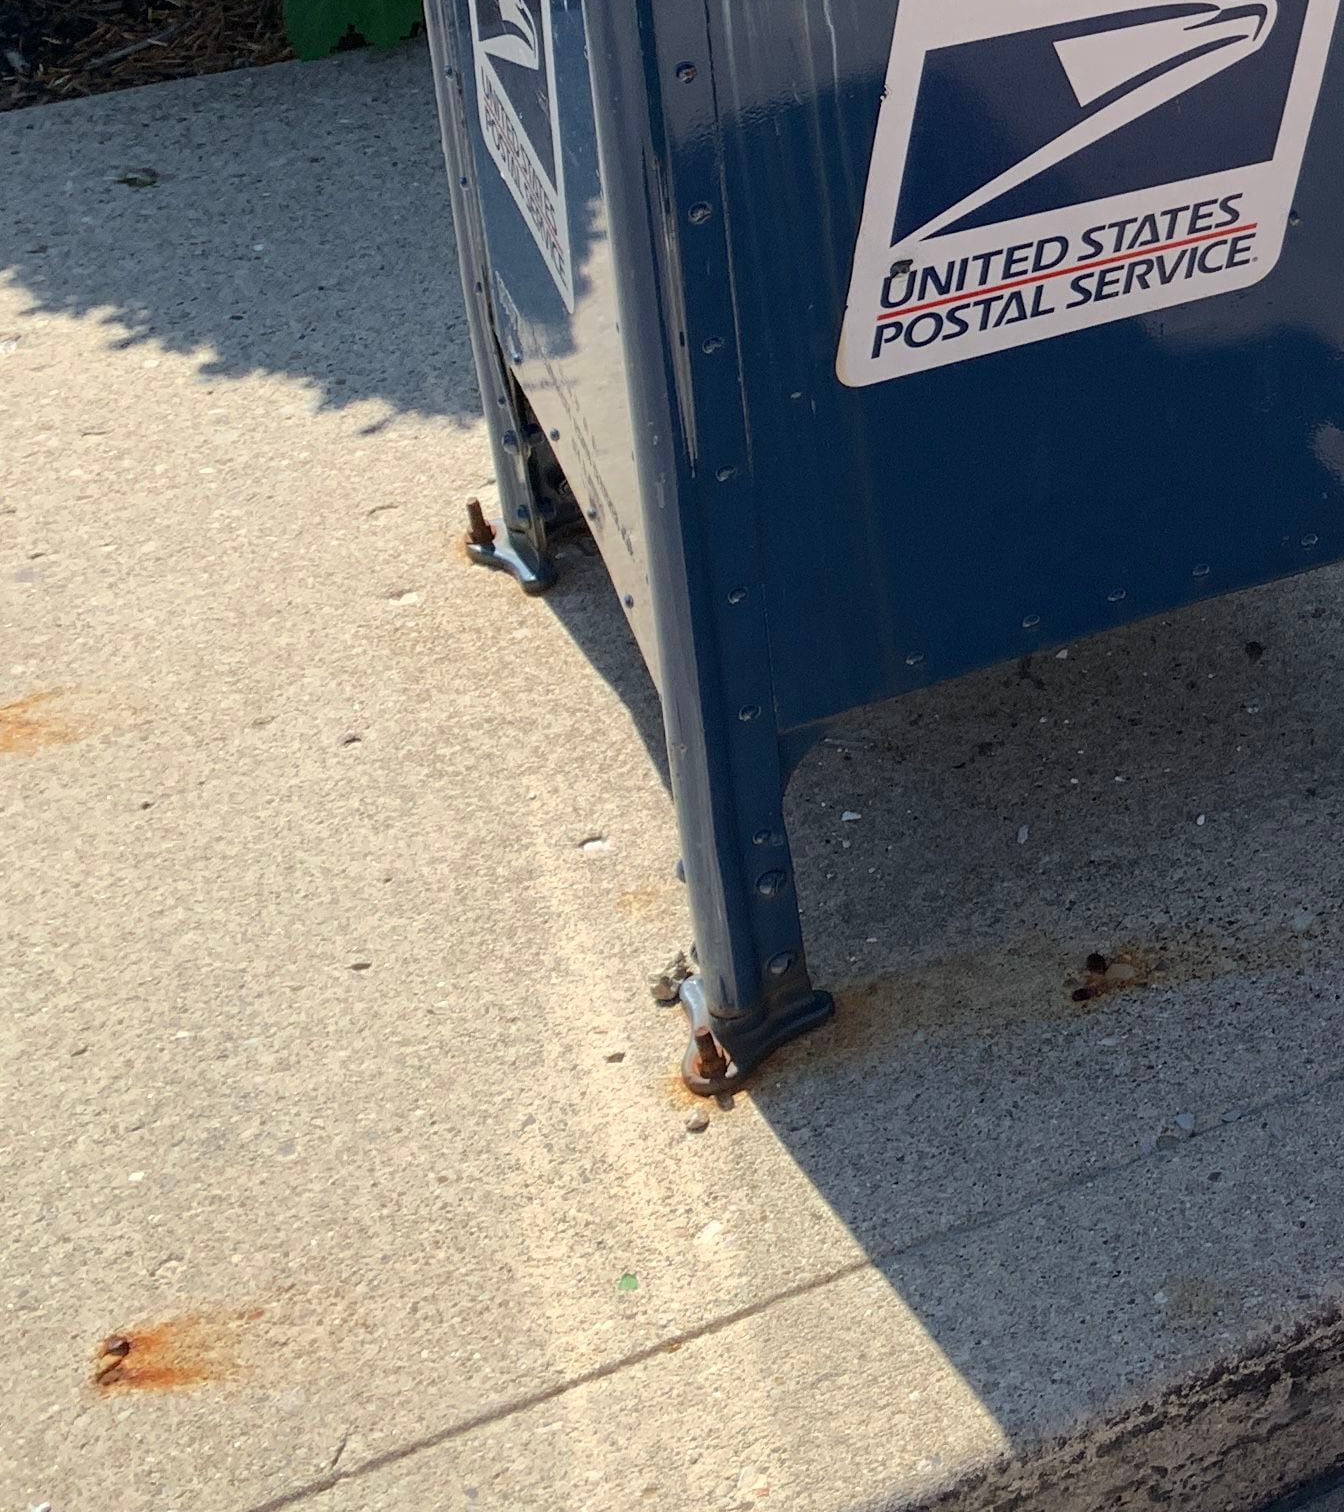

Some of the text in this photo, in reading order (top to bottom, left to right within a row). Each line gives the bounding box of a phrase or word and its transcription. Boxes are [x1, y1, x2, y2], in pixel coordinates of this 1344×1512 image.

[481, 64, 557, 238] UNITED STATES
[485, 105, 567, 289] POSTAL SERVICE
[871, 233, 1257, 359] POSTAL SERVICE
[880, 192, 1244, 310] UNITED STATES
